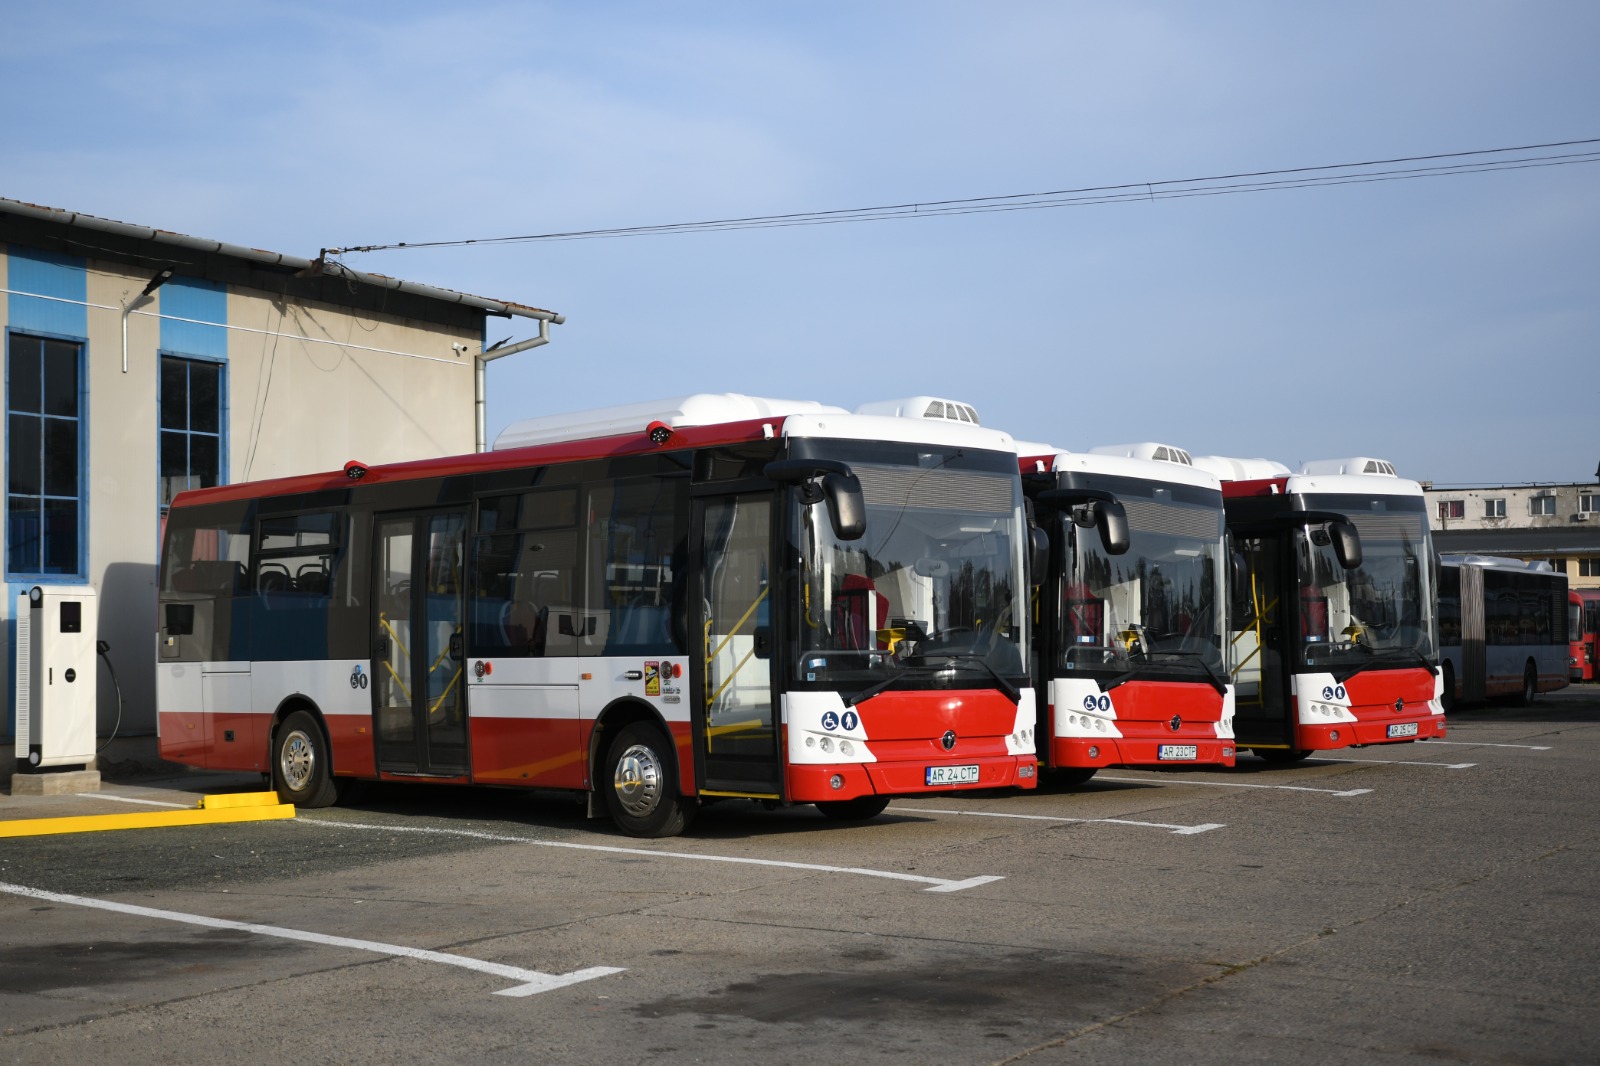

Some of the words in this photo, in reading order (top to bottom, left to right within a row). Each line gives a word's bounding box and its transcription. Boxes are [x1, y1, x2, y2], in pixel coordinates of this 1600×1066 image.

[1163, 746, 1174, 757] AR
[932, 768, 945, 781] AR
[947, 768, 958, 781] 24
[960, 766, 978, 780] CTP
